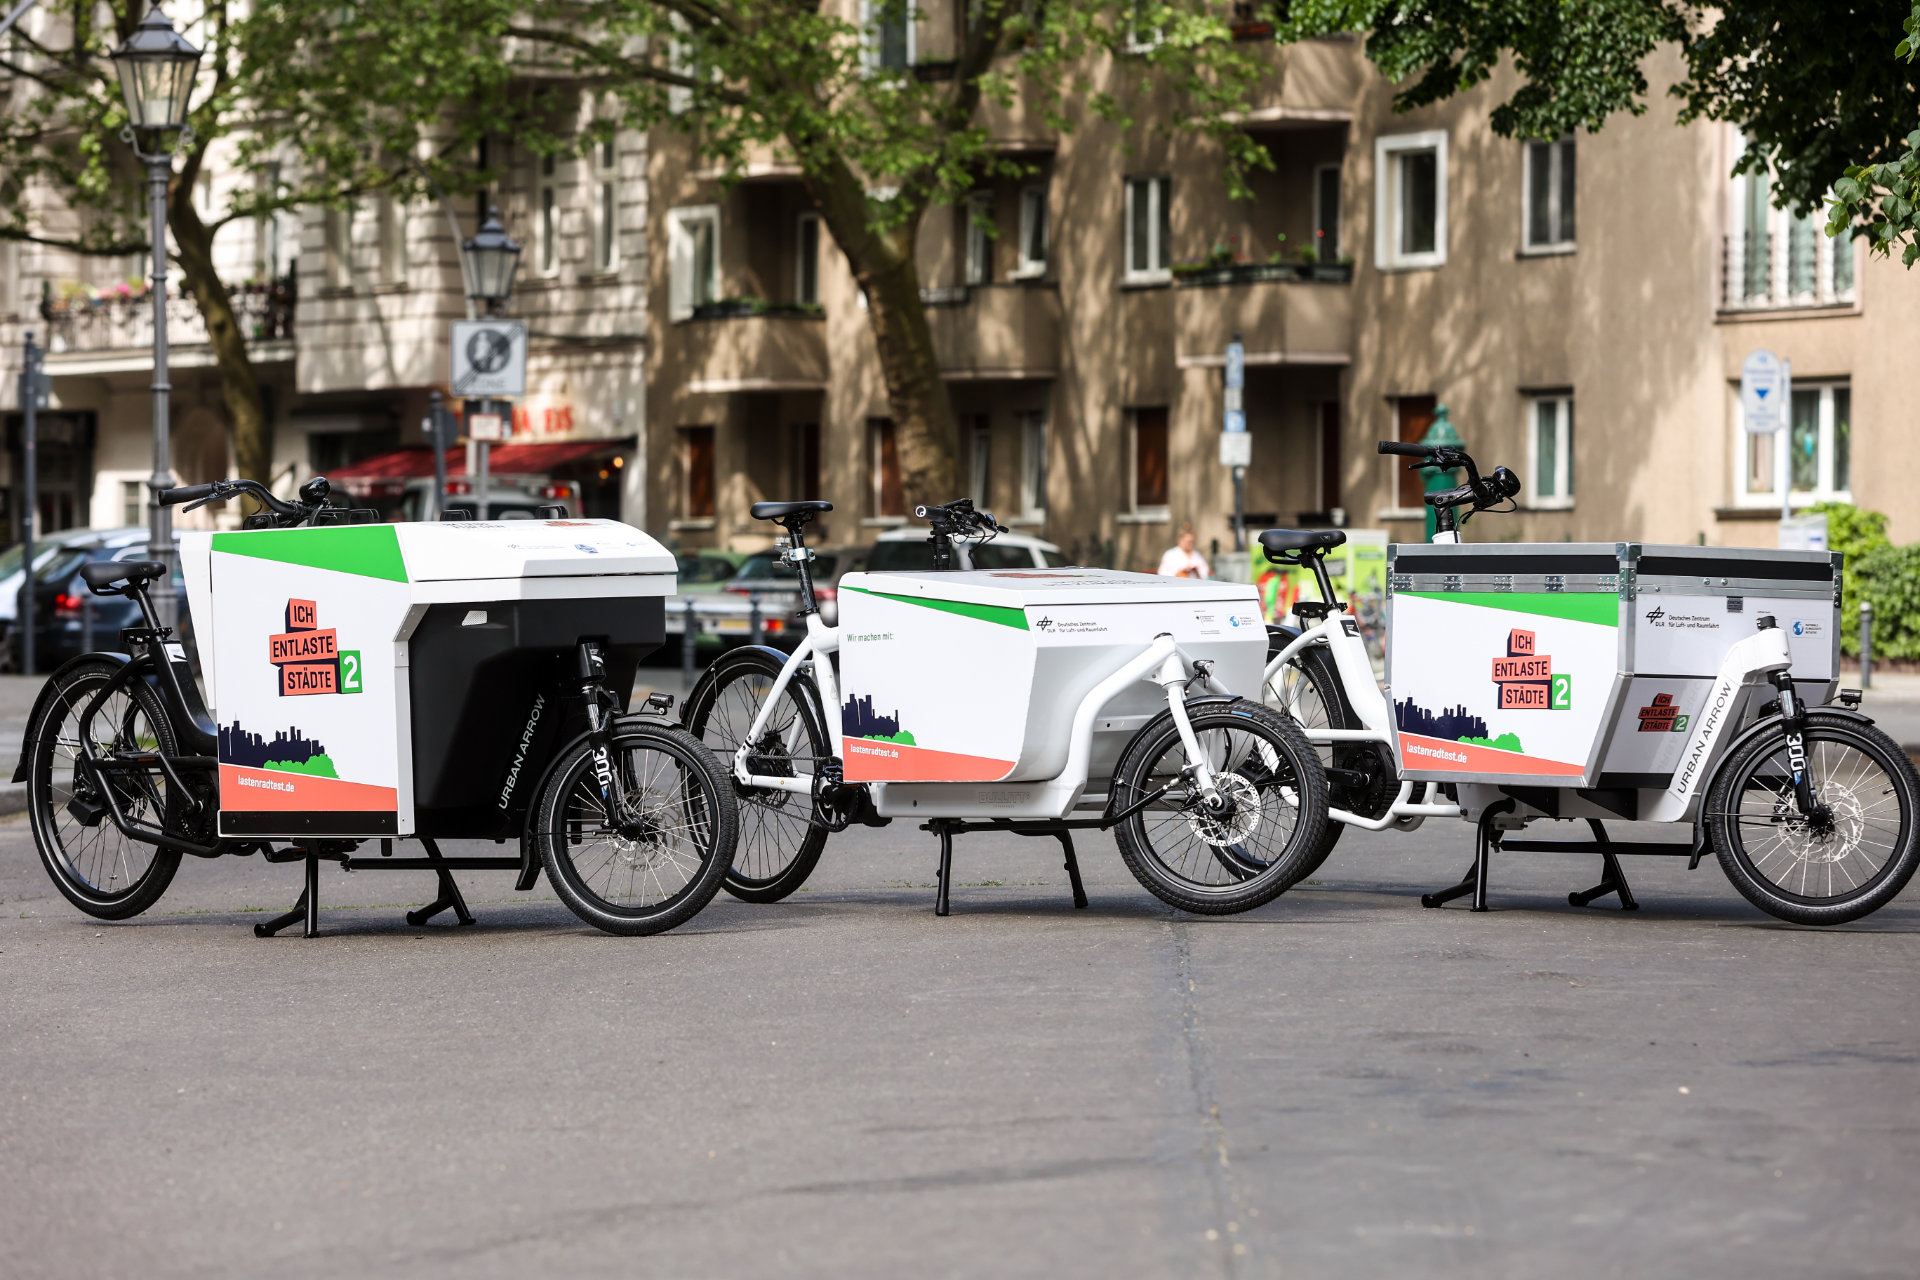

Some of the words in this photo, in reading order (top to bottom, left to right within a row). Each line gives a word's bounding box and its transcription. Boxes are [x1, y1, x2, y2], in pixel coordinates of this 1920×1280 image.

[293, 605, 314, 623] ICH
[846, 633, 857, 642] Wir
[857, 632, 881, 642] machen
[1514, 634, 1532, 650] ICH
[273, 635, 334, 658] ENTLASTE
[287, 667, 332, 690] STÄDTE
[343, 655, 360, 689] 2
[1494, 660, 1548, 677] ENTLASTE
[1505, 686, 1544, 705] STÄDTE
[1555, 678, 1569, 706] 2
[1659, 696, 1671, 704] ICH
[1640, 708, 1677, 717] ENTLASTE
[1644, 721, 1671, 730] STÄDTE
[1676, 716, 1687, 731] 2
[1677, 740, 1706, 794] URBAN
[1702, 681, 1732, 741] ARROW
[498, 753, 524, 810] URBAN
[519, 693, 546, 755] ARROW
[851, 743, 899, 759] lastenradtest.de
[1406, 741, 1468, 763] lastenradtest.de
[237, 774, 295, 792] lastenradtest.de
